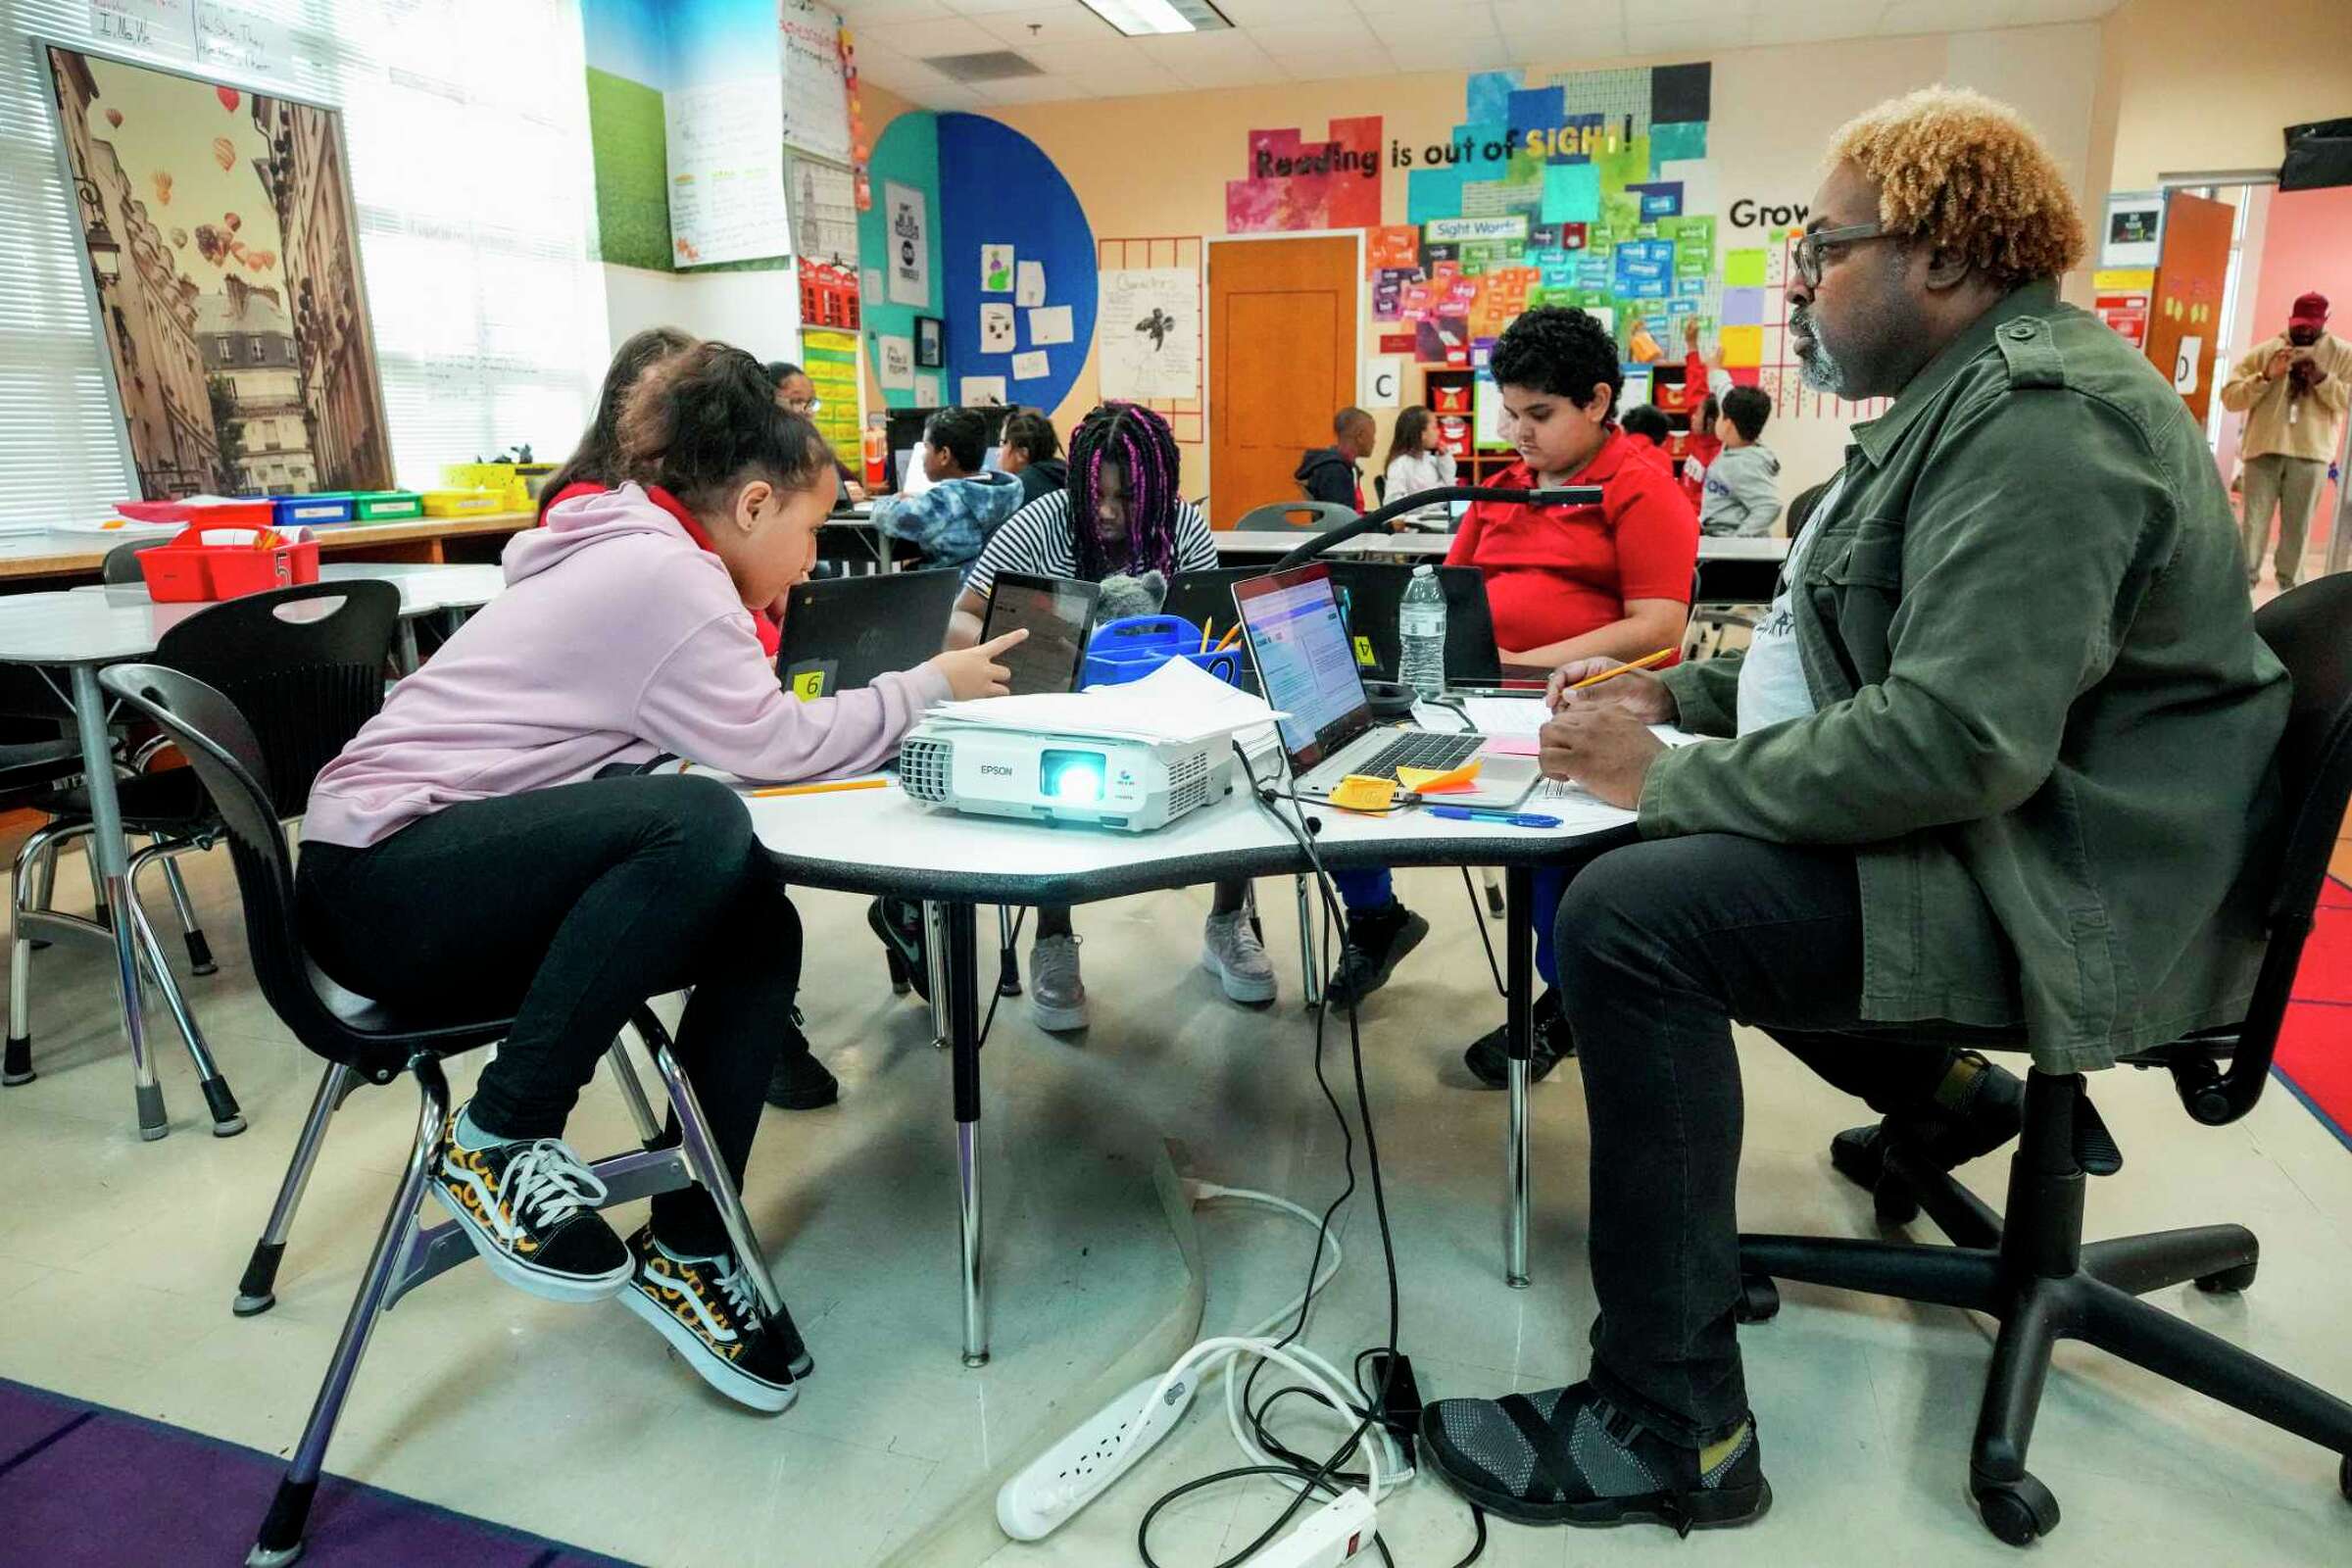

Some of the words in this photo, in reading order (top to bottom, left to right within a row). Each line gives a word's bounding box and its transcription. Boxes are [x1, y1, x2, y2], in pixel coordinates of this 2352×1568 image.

[1256, 141, 1378, 178] Reading
[1392, 140, 1412, 168] is
[1424, 136, 1475, 165] out
[1483, 128, 1519, 161] of
[1437, 222, 1470, 240] Sight
[1475, 220, 1515, 234] Words
[2177, 355, 2190, 383] D
[1375, 373, 1393, 399] C
[1442, 391, 1460, 410] A
[274, 549, 293, 588] 5
[1358, 641, 1370, 657] 4
[807, 675, 819, 695] 6
[981, 764, 1013, 776] EPSON
